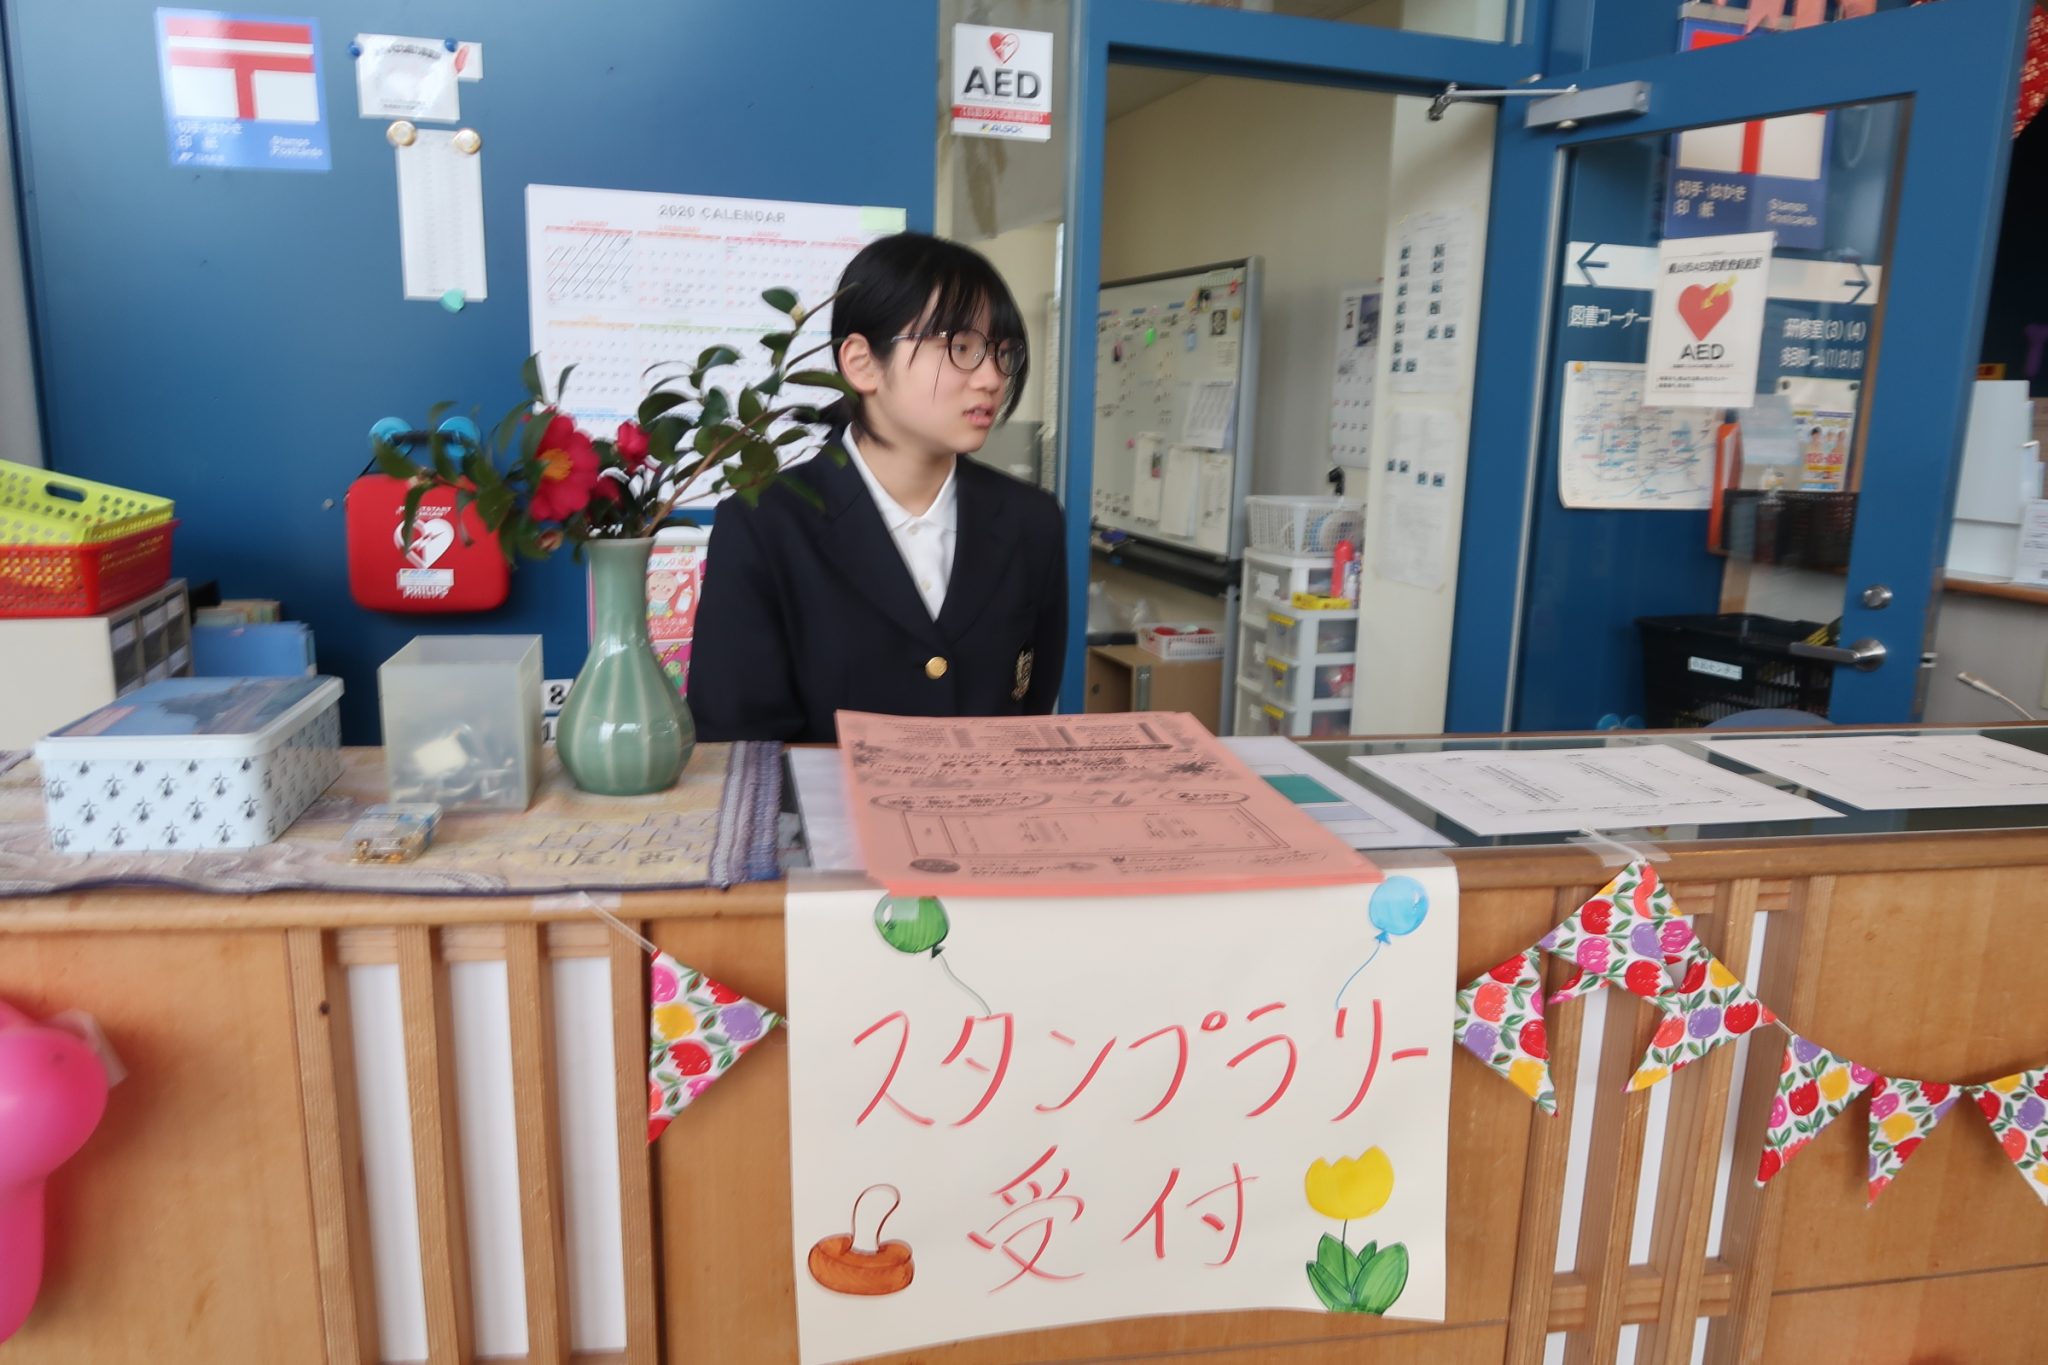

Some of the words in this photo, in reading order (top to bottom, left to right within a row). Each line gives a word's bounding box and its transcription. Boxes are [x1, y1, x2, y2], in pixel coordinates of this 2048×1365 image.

[962, 66, 1042, 98] AED
[659, 204, 696, 218] 2020
[701, 207, 786, 223] CALENDAR
[1568, 304, 1652, 329] 図書コーナー
[1680, 343, 1725, 360] AED
[404, 586, 450, 599] PHILIPS
[852, 998, 1429, 1127] スタンプラリー
[967, 1144, 1259, 1293] 受付
